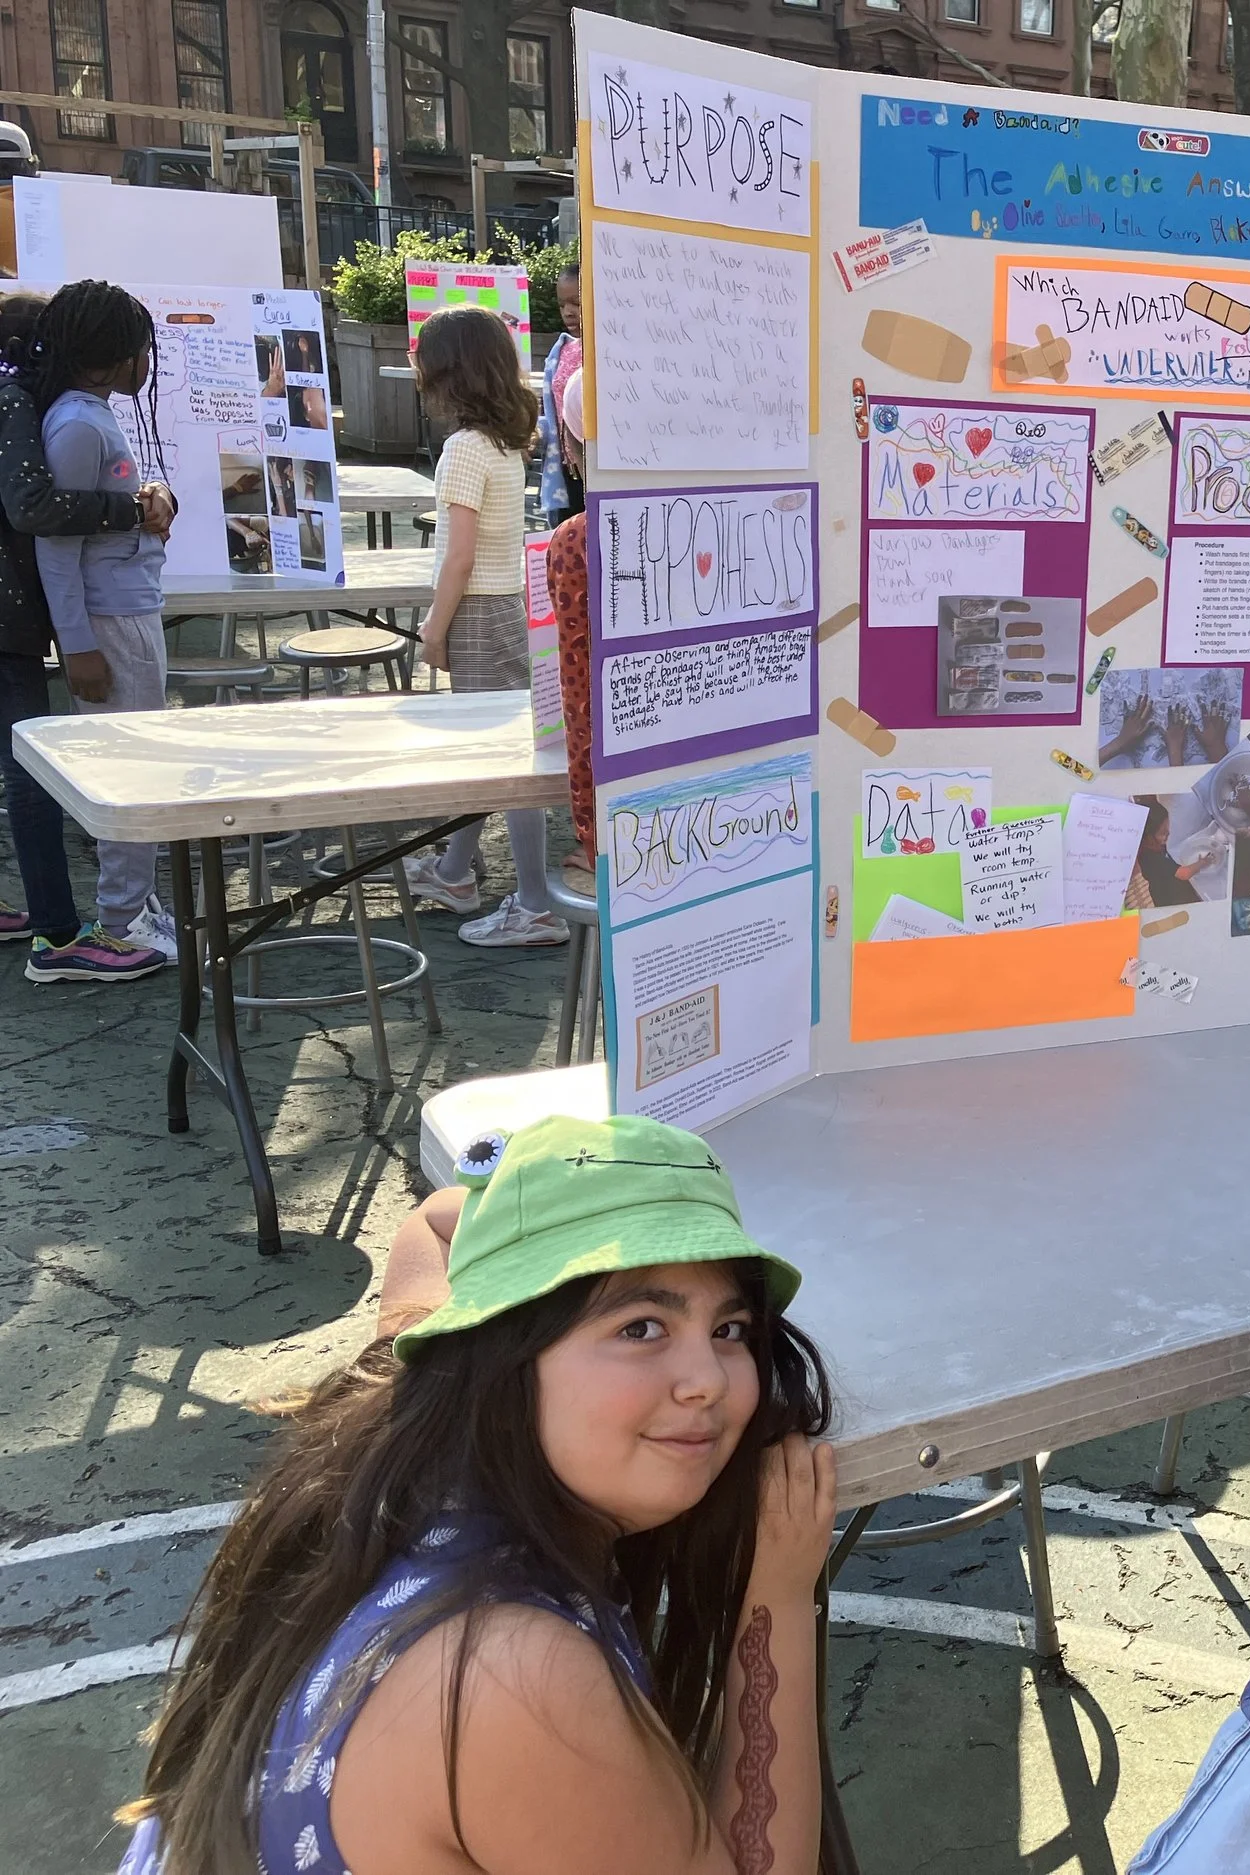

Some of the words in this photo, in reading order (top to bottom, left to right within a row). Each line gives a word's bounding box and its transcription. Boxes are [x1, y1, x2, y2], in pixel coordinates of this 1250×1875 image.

[878, 99, 948, 126] Need
[604, 72, 803, 197] PURPOSE
[928, 145, 1012, 200] The
[1045, 162, 1163, 198] Adhesive
[1003, 200, 1044, 230] Olive
[1115, 208, 1148, 238] Lila
[846, 234, 880, 255] BAND-AID
[854, 255, 889, 276] BAND-AID
[1013, 271, 1079, 296] Which
[1062, 293, 1185, 333] BANDAID
[1165, 326, 1211, 343] works
[878, 452, 1057, 515] Materials
[605, 498, 806, 628] HYPOTHESIS
[611, 657, 650, 675] After
[715, 639, 729, 651] and
[733, 634, 776, 649] comparing
[778, 630, 811, 642] different
[611, 672, 641, 689] brands
[645, 668, 656, 680] of
[727, 649, 750, 660] think
[755, 644, 786, 654] Amazon
[612, 690, 619, 699] is
[624, 684, 638, 698] the
[644, 677, 682, 692] stickiest
[685, 672, 701, 683] and
[707, 665, 723, 678] will
[729, 659, 750, 672] work
[753, 655, 766, 665] the
[767, 653, 785, 663] best
[665, 687, 682, 699] say
[686, 683, 700, 693] this
[705, 674, 738, 689] because
[742, 668, 753, 678] all
[757, 664, 769, 673] the
[612, 704, 655, 724] bandages
[689, 690, 714, 704] holes
[719, 687, 734, 696] and
[737, 679, 755, 692] will
[758, 674, 782, 686] affect
[785, 673, 799, 683] the
[868, 779, 968, 846] Data
[966, 827, 995, 839] Further
[969, 835, 998, 848] water
[1006, 825, 1042, 840] temp?
[973, 854, 988, 862] We
[994, 847, 1010, 856] will
[1016, 844, 1032, 855] try
[982, 864, 1006, 873] room
[971, 880, 1013, 895] Running
[1020, 871, 1050, 883] water
[980, 896, 992, 904] or
[1002, 887, 1026, 900] dip?
[994, 917, 1022, 928] both?
[997, 907, 1014, 917] will
[1020, 903, 1036, 914] try
[669, 996, 705, 1017] BAND-AID
